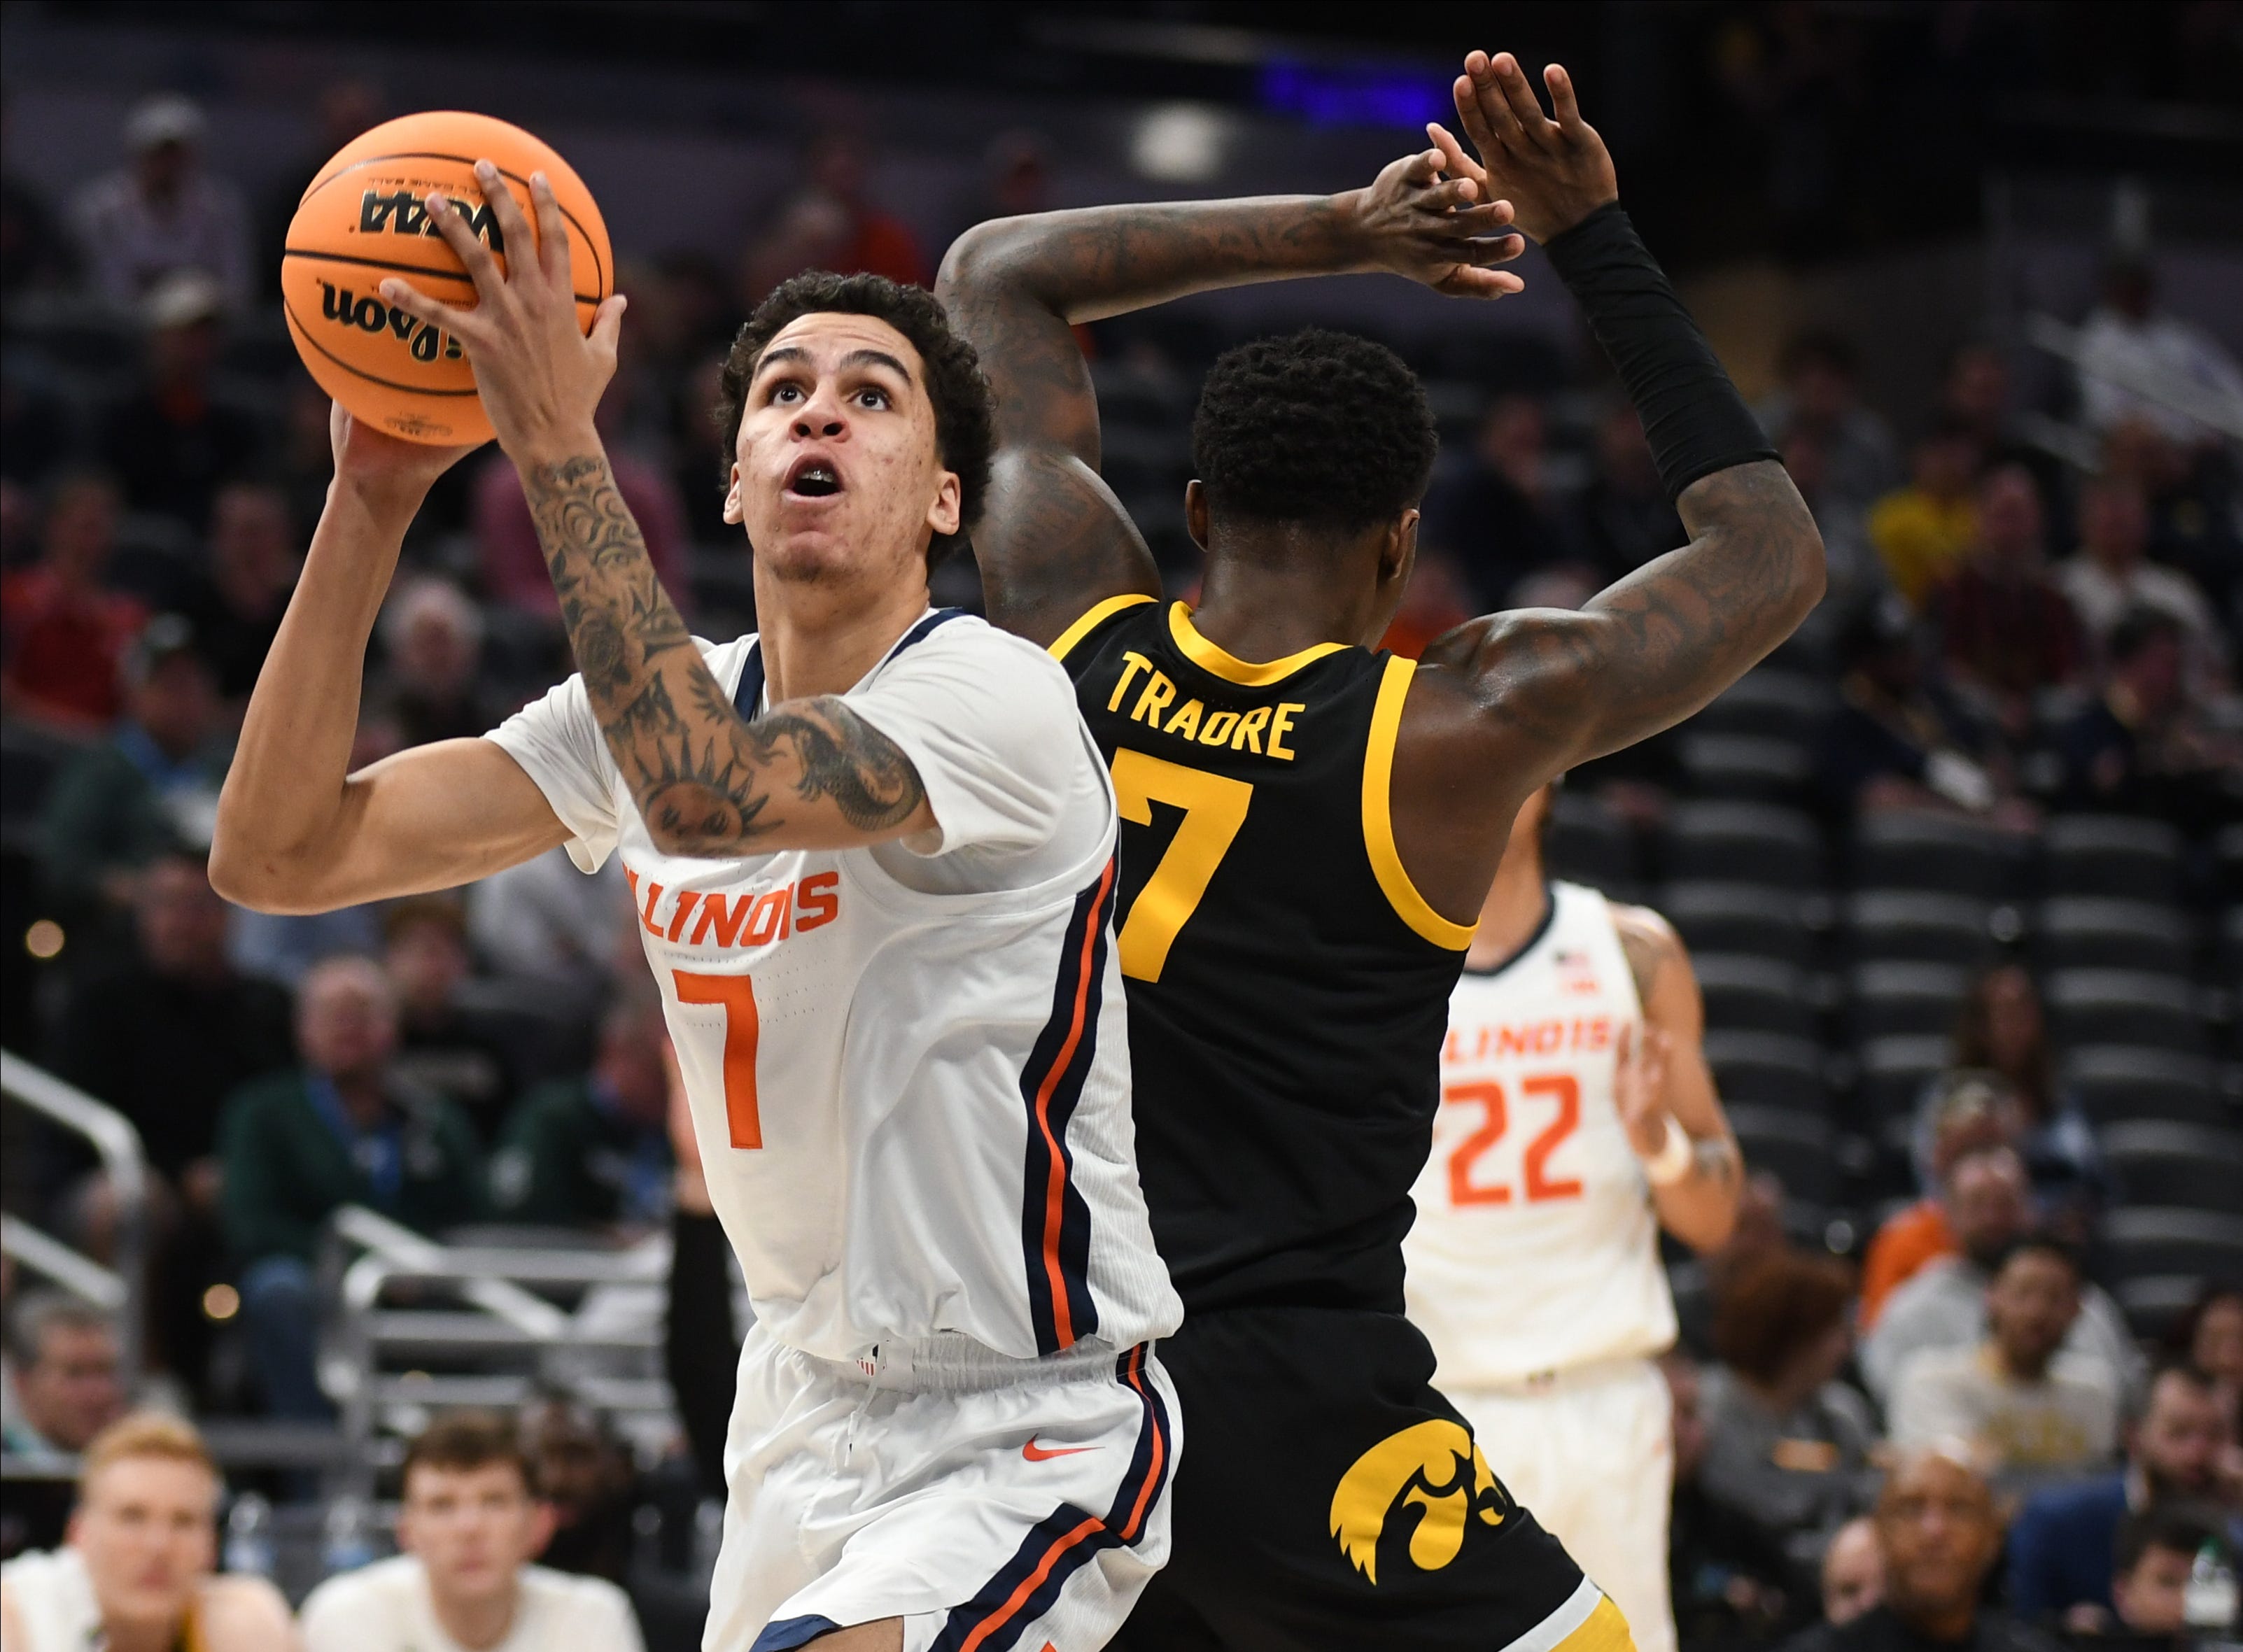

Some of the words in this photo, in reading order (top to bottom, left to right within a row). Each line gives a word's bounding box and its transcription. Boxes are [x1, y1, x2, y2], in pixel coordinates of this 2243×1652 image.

[321, 281, 471, 362] ilson
[1107, 651, 1305, 761] TRAORE
[622, 861, 838, 947] LINOIS
[1110, 746, 1253, 983] 7
[672, 969, 763, 1149] 7
[1442, 1016, 1611, 1064] LINOIS
[1444, 1074, 1584, 1207] 22
